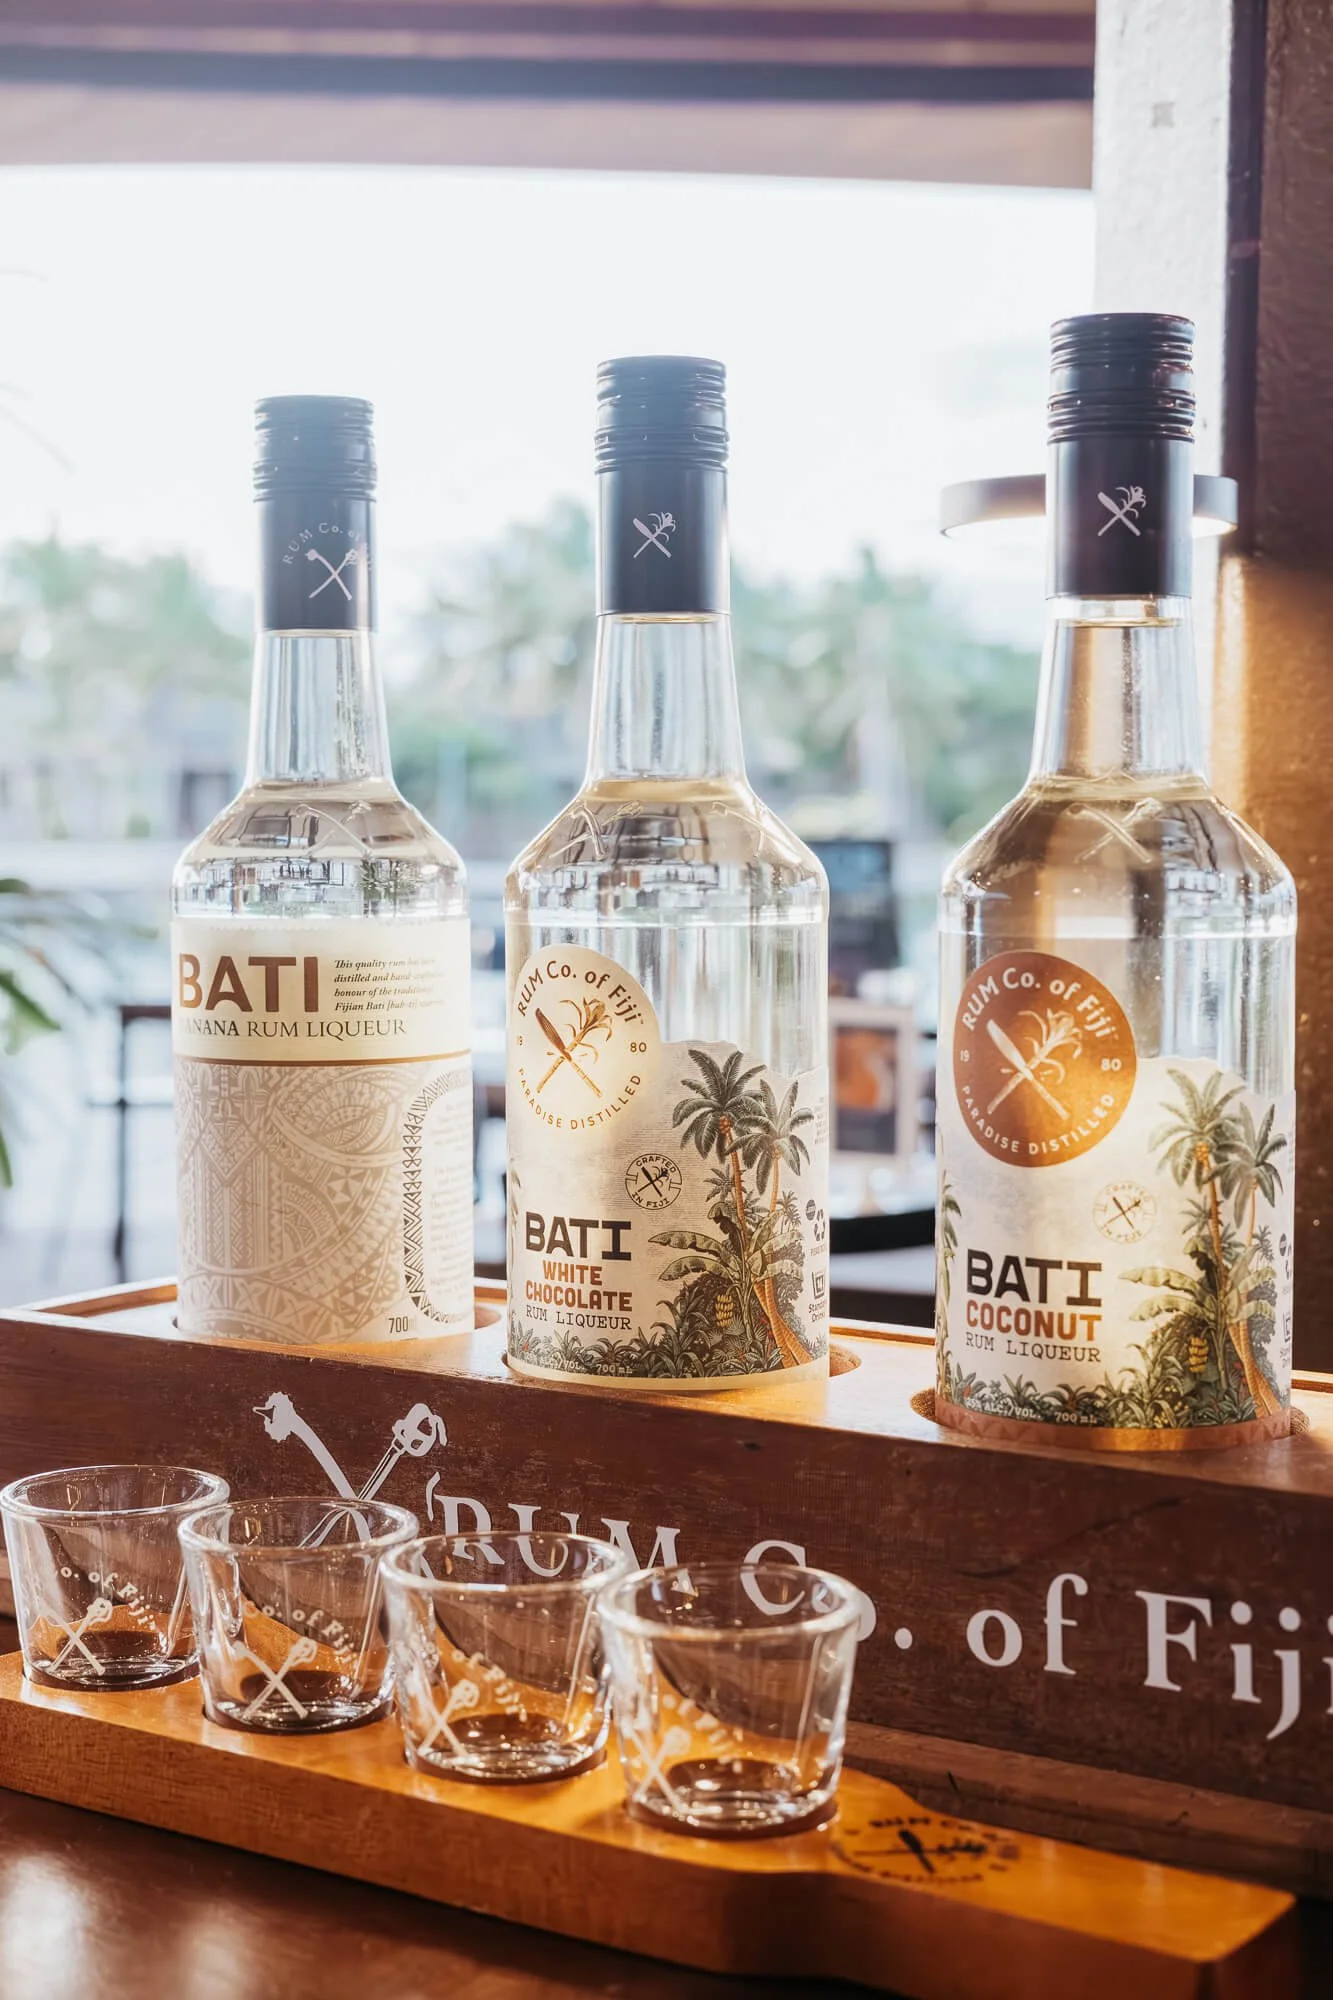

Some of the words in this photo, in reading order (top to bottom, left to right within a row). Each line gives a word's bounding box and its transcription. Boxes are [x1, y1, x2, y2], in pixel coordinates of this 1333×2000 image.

[282, 528, 313, 564] RUM
[318, 522, 343, 534] Co.
[334, 960, 353, 969] This
[355, 959, 386, 970] quality
[334, 973, 371, 983] distilled
[372, 972, 389, 981] and
[179, 953, 319, 1012] BATI
[334, 988, 367, 997] honour
[369, 987, 379, 999] of
[518, 968, 543, 1016] RUM
[546, 960, 576, 980] Co.
[584, 970, 610, 989] of
[607, 984, 640, 1024] Fiji
[335, 1001, 364, 1013] Fijian
[366, 1001, 385, 1011] Bati
[962, 975, 999, 1031] RUM
[1002, 967, 1041, 990] Co.
[1049, 979, 1081, 1000] of
[1076, 994, 1116, 1039] Fiji
[183, 1018, 240, 1036] ANANA
[247, 1021, 299, 1037] RUM
[306, 1019, 408, 1041] LIQUEUR
[630, 1042, 647, 1053] 80
[1100, 1057, 1122, 1072] 80
[518, 1068, 563, 1129] PARADISE
[570, 1074, 641, 1130] DISTILLED
[962, 1085, 1020, 1154] PARADISE
[1028, 1093, 1115, 1155] DISTILLED
[636, 1156, 676, 1173] CRAFTED
[632, 1192, 643, 1203] IN
[646, 1197, 670, 1208] FIJI
[526, 1211, 632, 1261] BATI
[543, 1260, 603, 1286] WHITE
[967, 1249, 1102, 1307] BATI
[526, 1279, 632, 1312] CHOCOLATE
[526, 1304, 548, 1321] RUM
[556, 1306, 632, 1330] LIQUEUR
[966, 1300, 1102, 1341] COCONUT
[966, 1332, 995, 1352] RUM
[1006, 1340, 1101, 1363] LIQUEUR
[597, 1363, 616, 1373] 700
[1055, 1411, 1077, 1423] 700
[88, 1571, 118, 1588] of
[433, 1494, 698, 1597] RUM
[966, 1573, 1088, 1676] of
[293, 1609, 324, 1627] of
